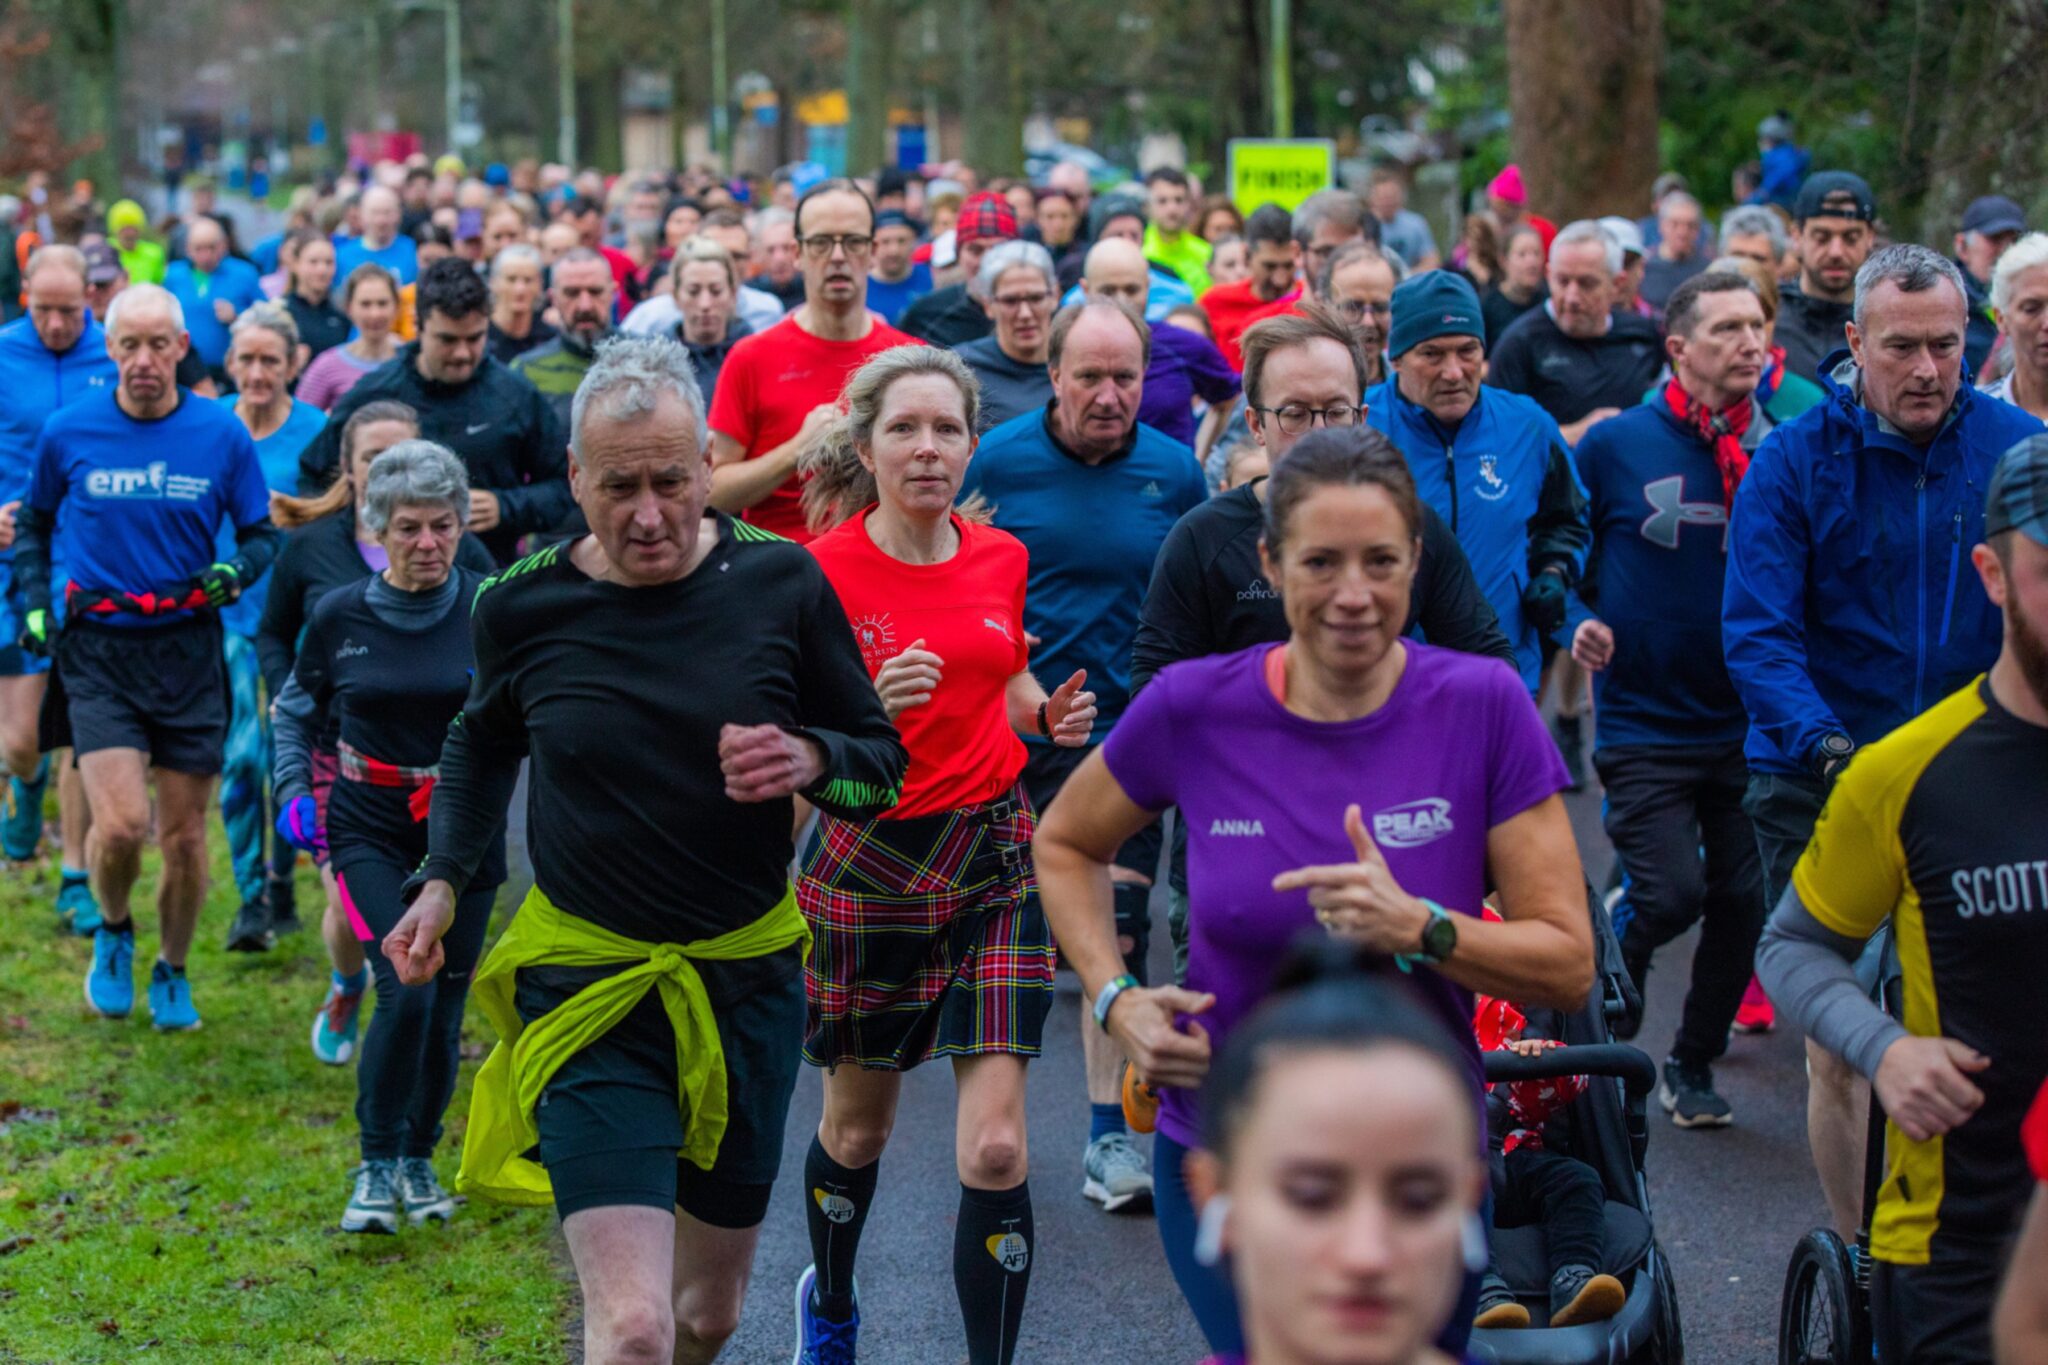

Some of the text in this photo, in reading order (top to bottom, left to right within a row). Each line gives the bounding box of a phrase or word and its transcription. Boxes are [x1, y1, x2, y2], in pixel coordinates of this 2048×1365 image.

[1236, 580, 1280, 601] parkru
[875, 647, 898, 657] RUN
[1209, 819, 1266, 837] ANNA
[1373, 808, 1453, 836] PEAK
